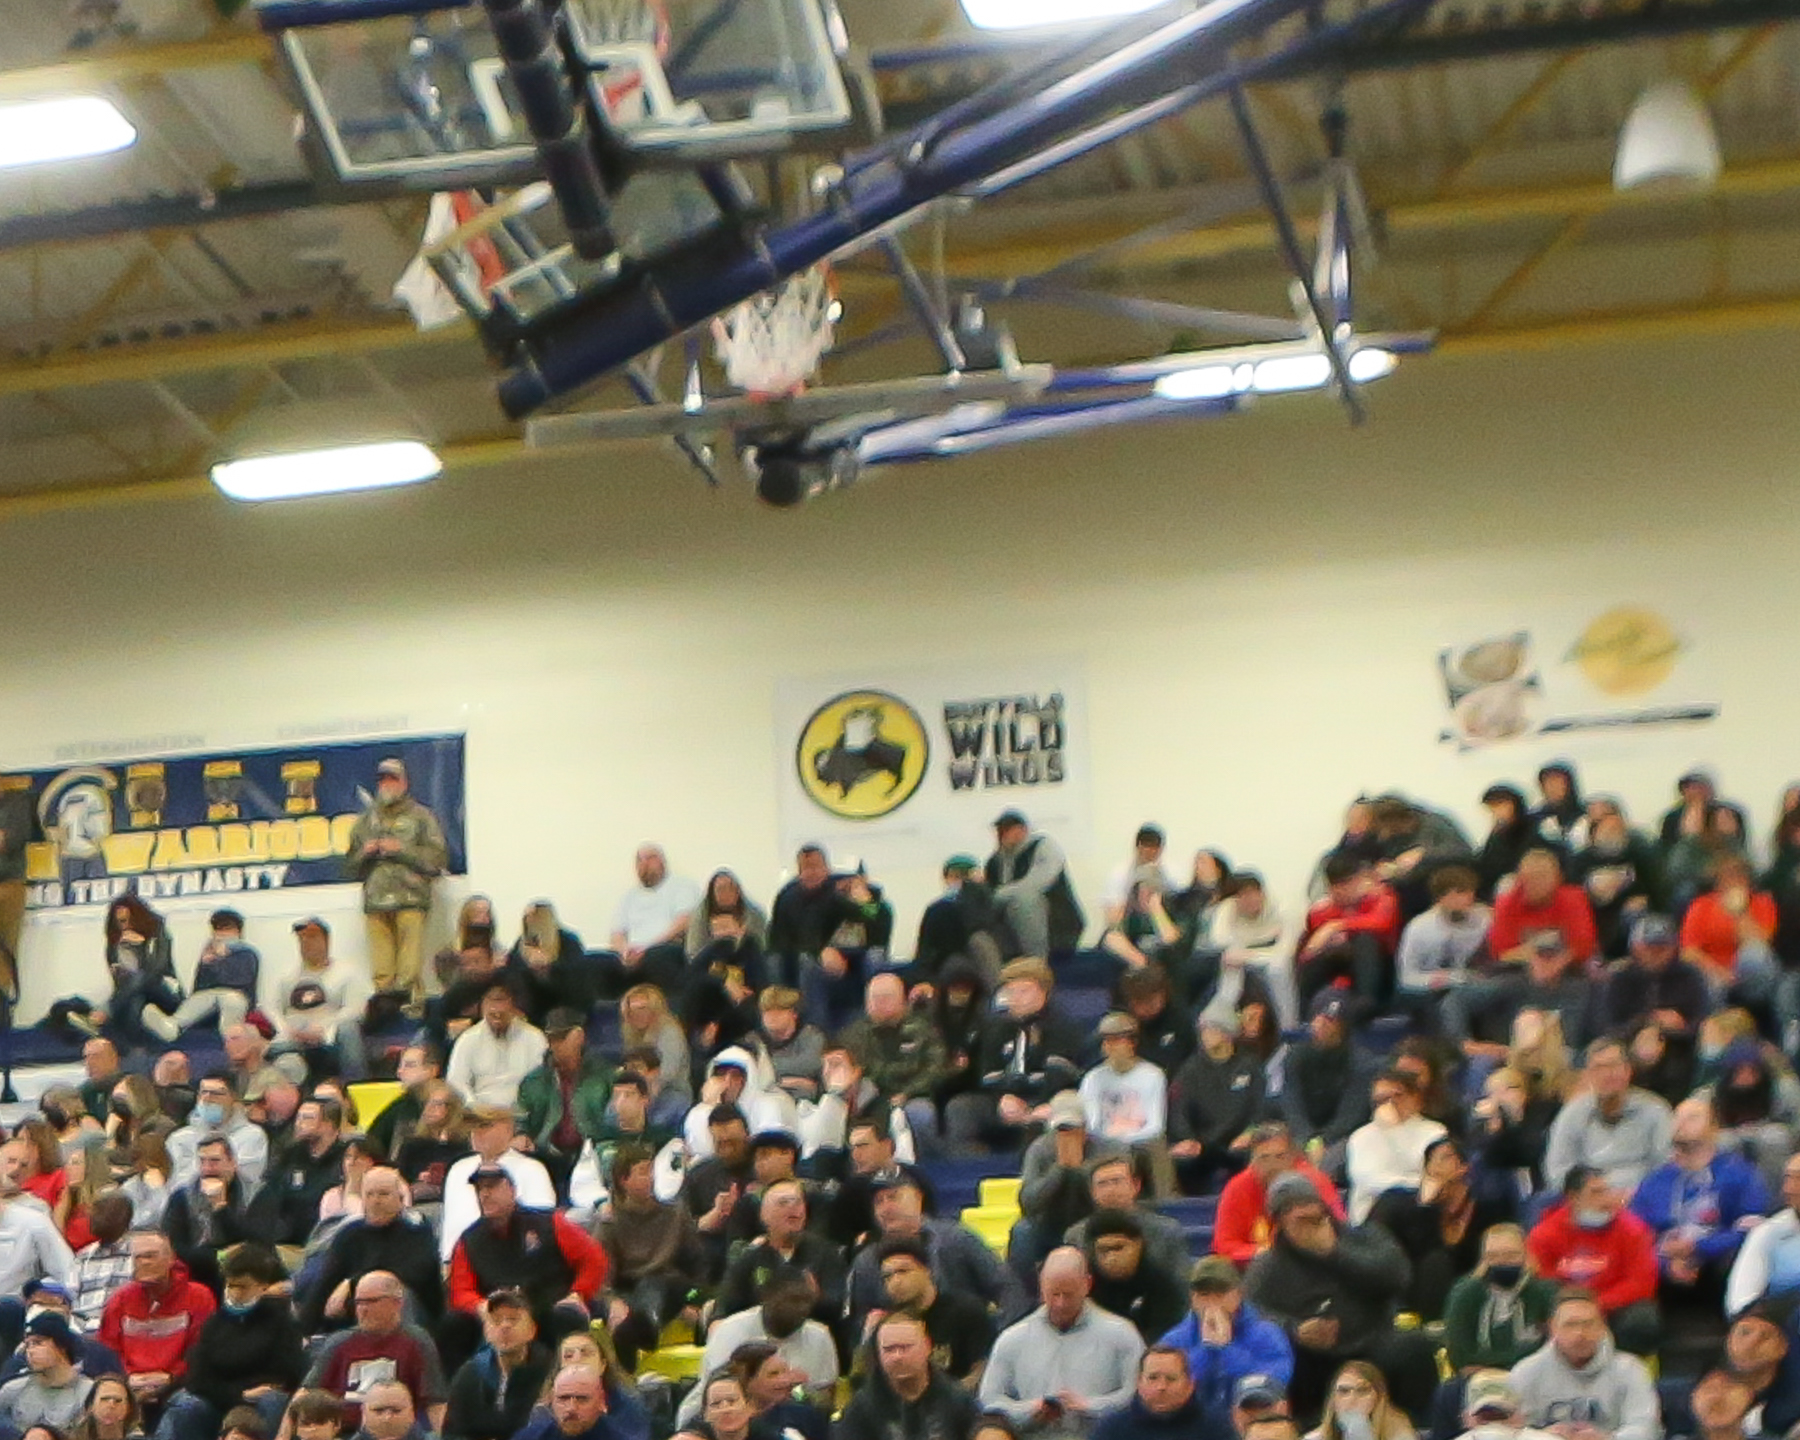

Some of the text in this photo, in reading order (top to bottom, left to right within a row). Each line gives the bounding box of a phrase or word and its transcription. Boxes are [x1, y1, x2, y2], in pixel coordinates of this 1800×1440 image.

[950, 718, 1062, 758] WILD
[951, 749, 1063, 790] WINGS
[137, 862, 289, 898] DYNASTY
